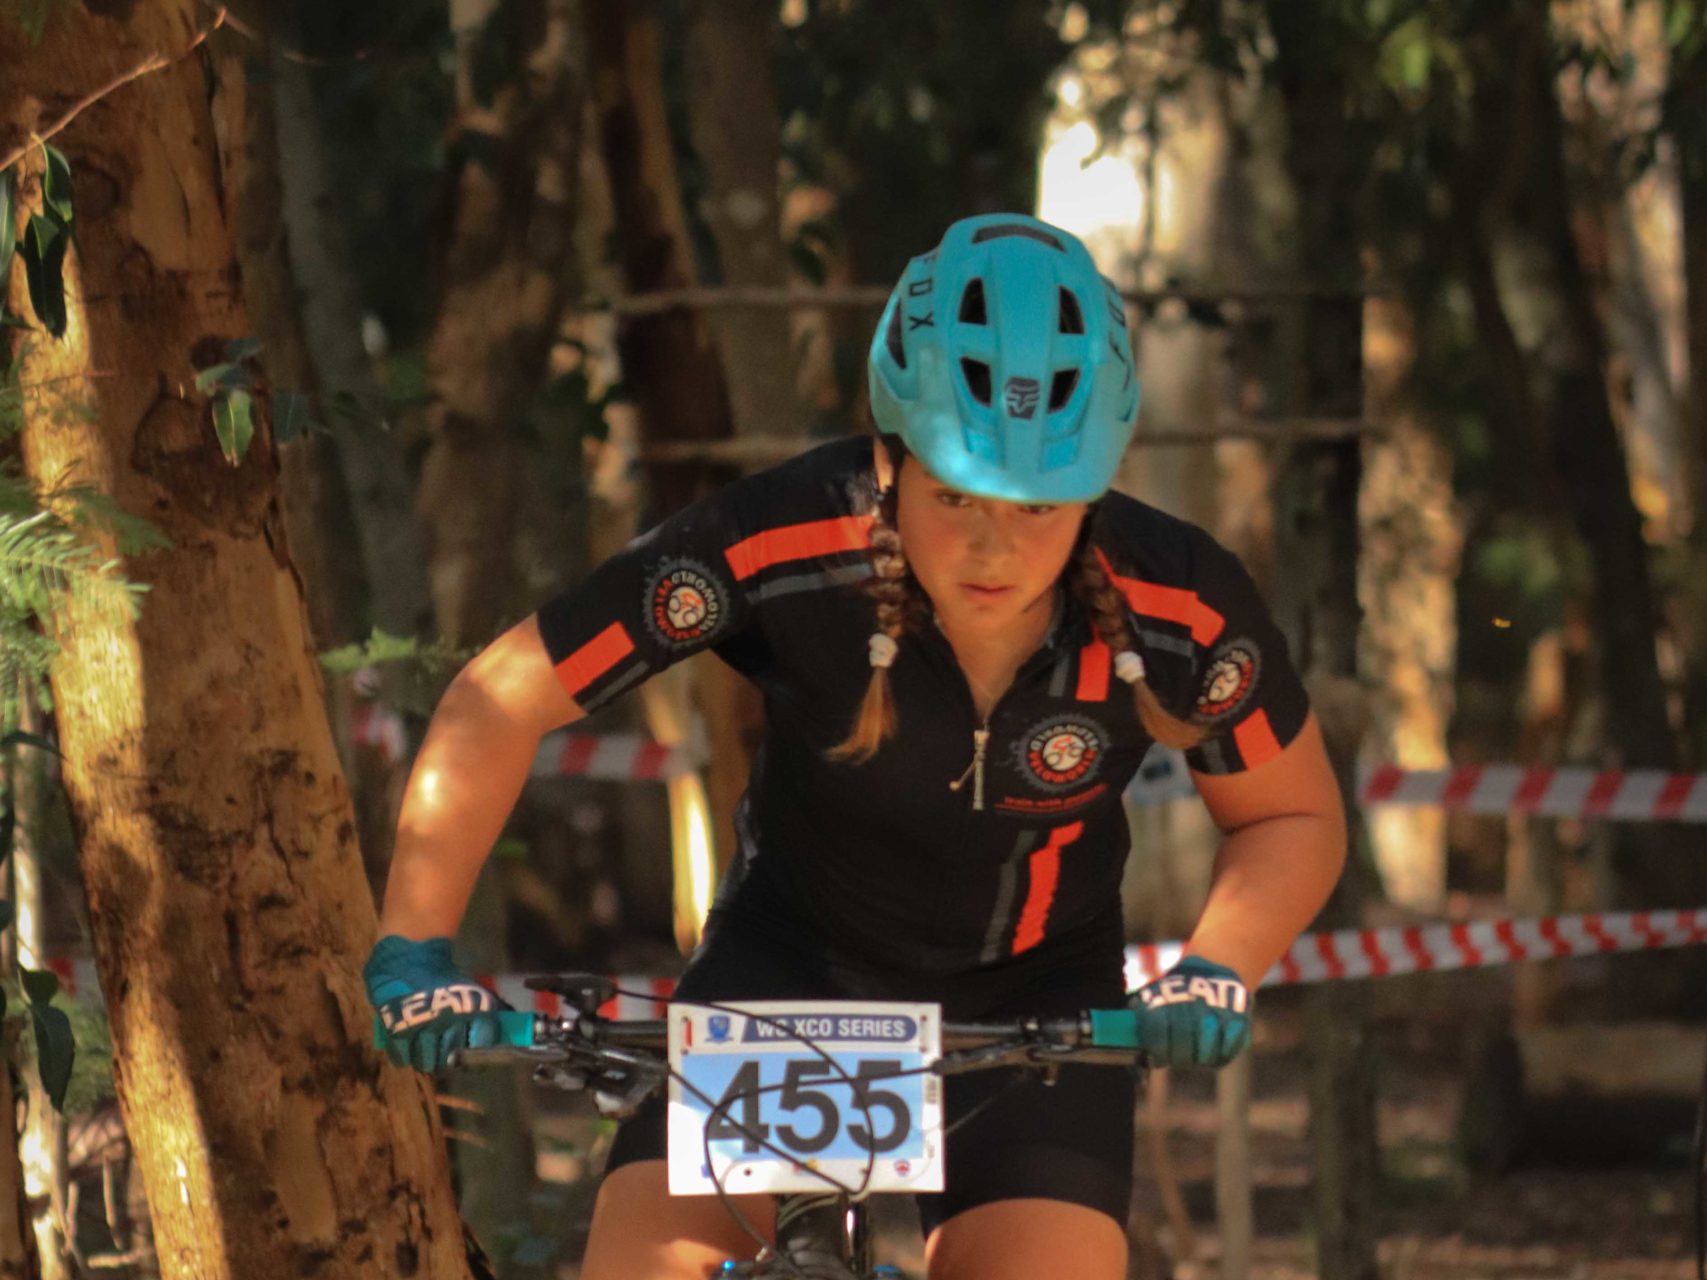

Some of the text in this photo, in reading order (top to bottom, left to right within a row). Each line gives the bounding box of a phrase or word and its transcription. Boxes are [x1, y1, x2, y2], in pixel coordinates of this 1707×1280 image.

[793, 1018, 833, 1038] XCO
[837, 1018, 907, 1038] SERIES
[705, 1059, 911, 1154] 455
